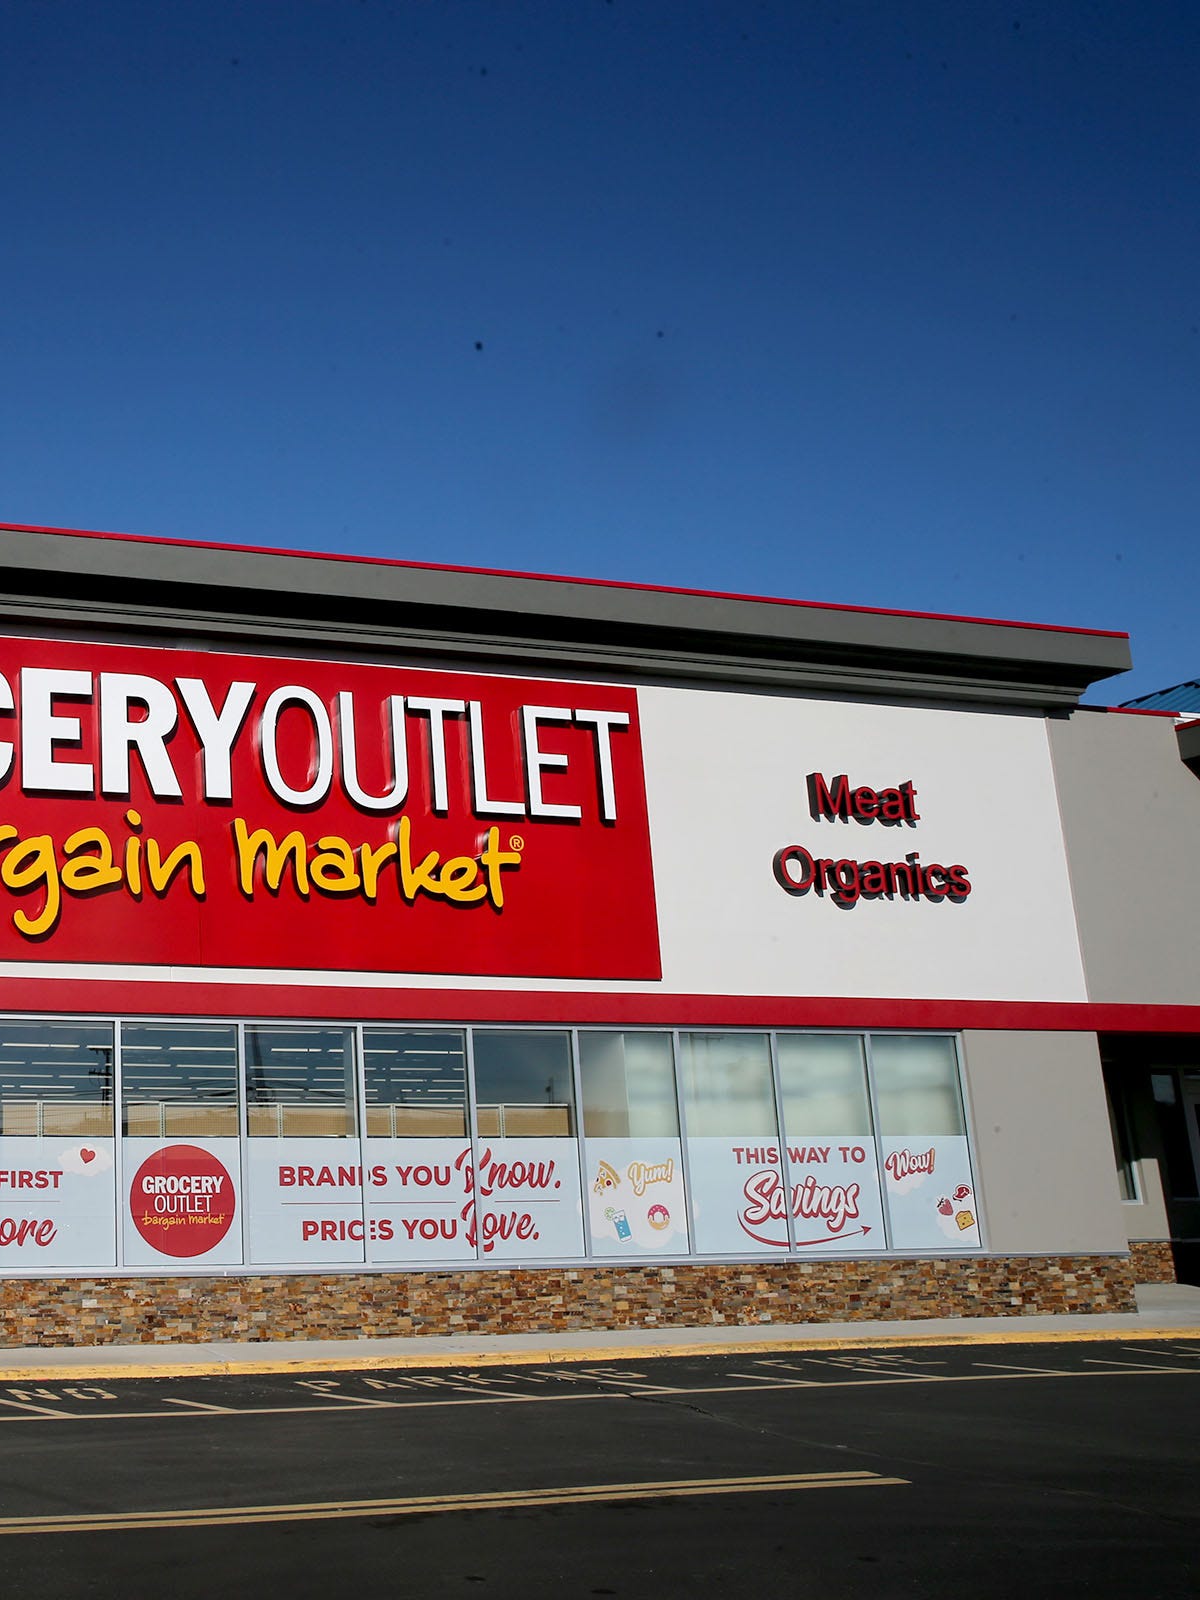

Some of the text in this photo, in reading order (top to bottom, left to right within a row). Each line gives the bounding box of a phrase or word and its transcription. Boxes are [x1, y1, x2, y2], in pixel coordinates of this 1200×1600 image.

[806, 772, 920, 828] Meat
[773, 845, 972, 909] Organics
[395, 1165, 451, 1187] YOU
[454, 1147, 560, 1196] Know.
[732, 1146, 866, 1165] THIS WAY TO
[884, 1147, 935, 1181] Wow!
[141, 1175, 224, 1194] GROCERY
[628, 1158, 673, 1196] Yum!
[154, 1195, 213, 1213] OUTLET
[743, 1169, 860, 1232] Savings
[141, 1210, 186, 1231] bargain
[401, 1219, 458, 1240] YOU
[460, 1199, 540, 1252] Love.
[6, 1387, 118, 1401] NO
[294, 1368, 648, 1392] PARKING
